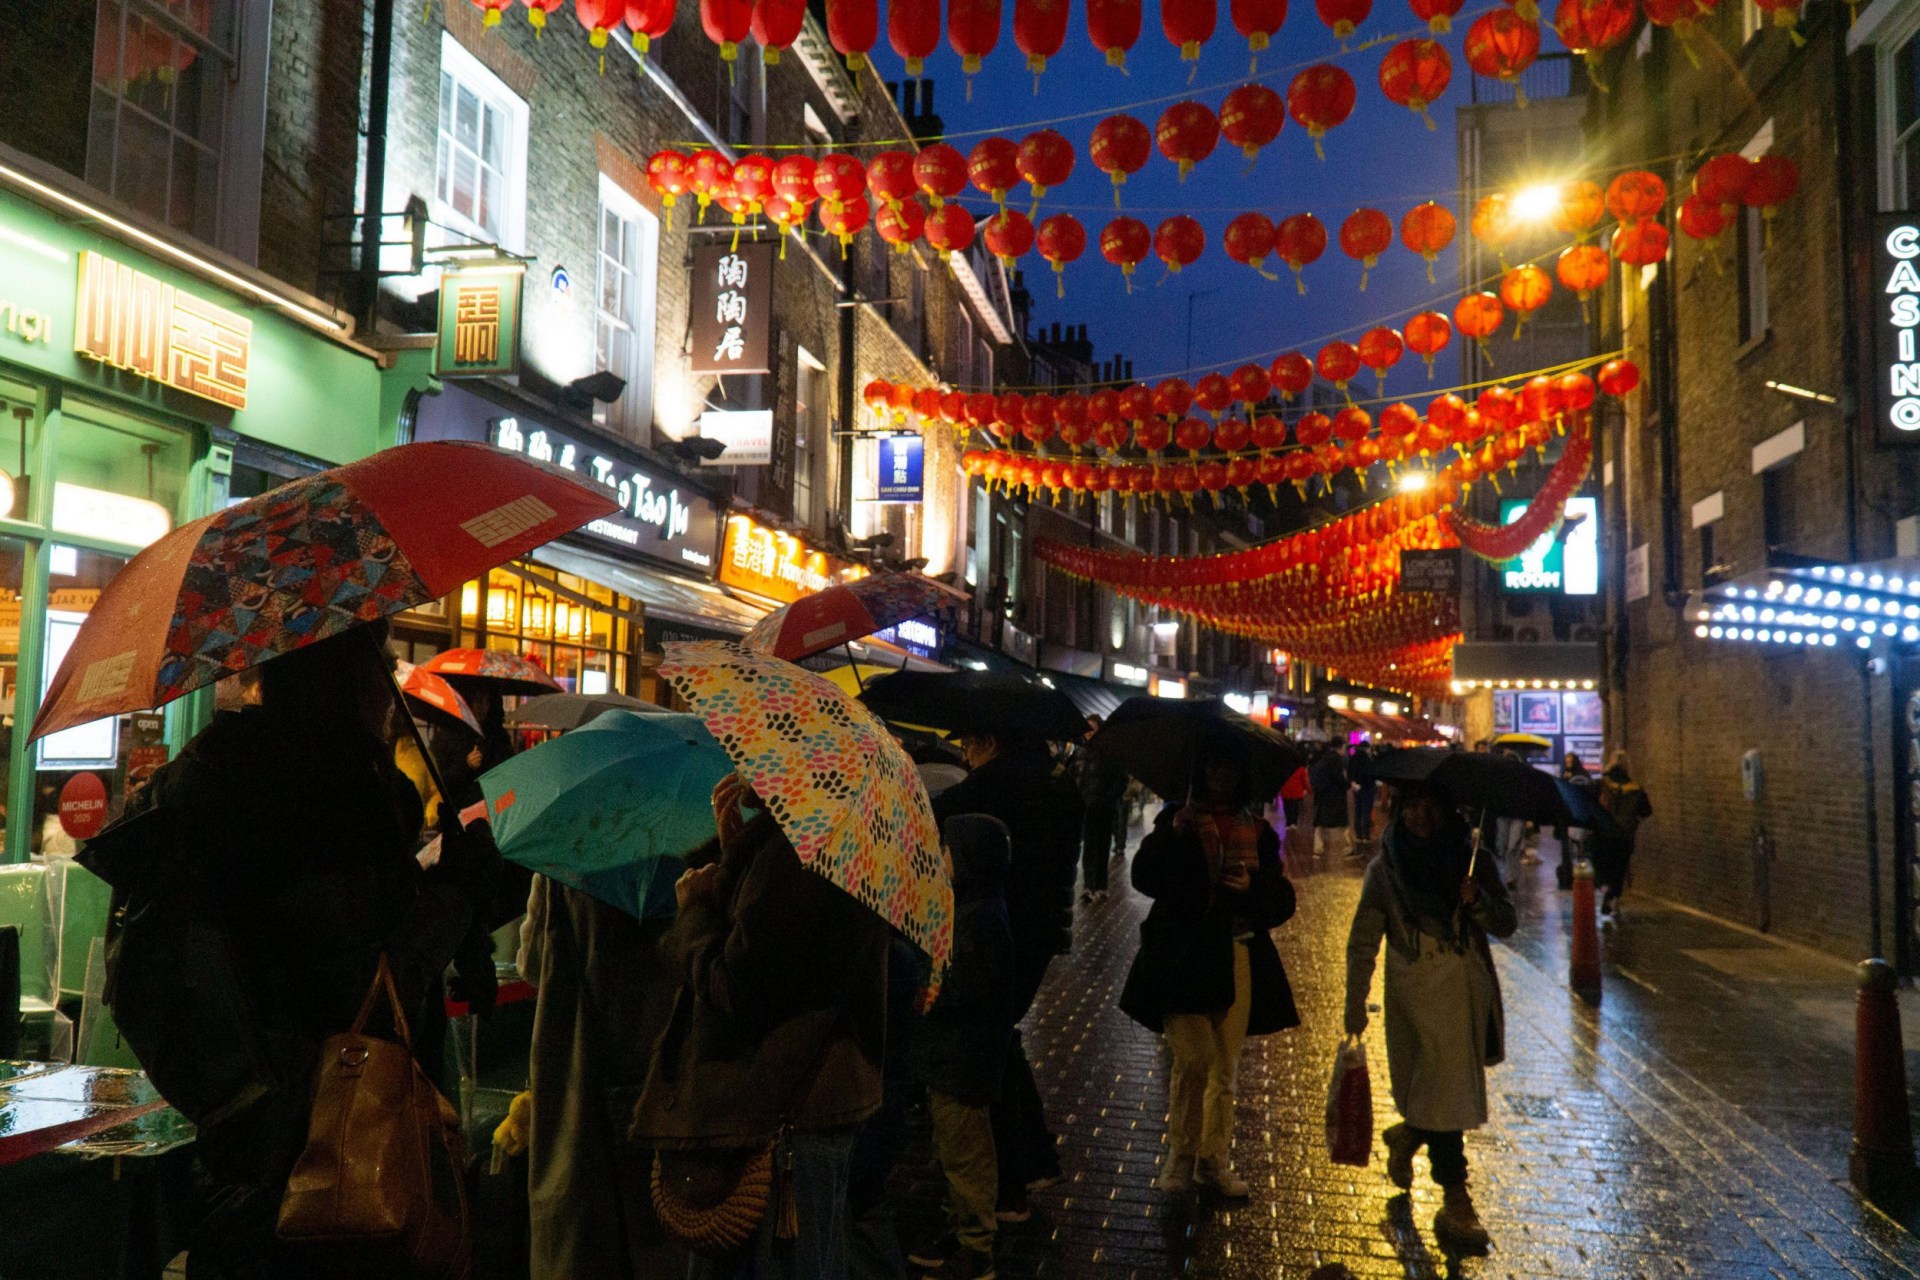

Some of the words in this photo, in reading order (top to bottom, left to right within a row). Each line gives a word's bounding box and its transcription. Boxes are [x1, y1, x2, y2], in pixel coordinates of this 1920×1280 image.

[714, 254, 748, 361] 陶陶居
[1886, 226, 1920, 430] CASINO
[632, 473, 667, 525] Tao
[666, 489, 688, 540] Ju
[588, 519, 639, 545] RESTAURANT
[1505, 571, 1560, 588] ROOM
[137, 720, 158, 731] open
[62, 799, 104, 812] MICHELIN
[73, 813, 91, 823] 2025
